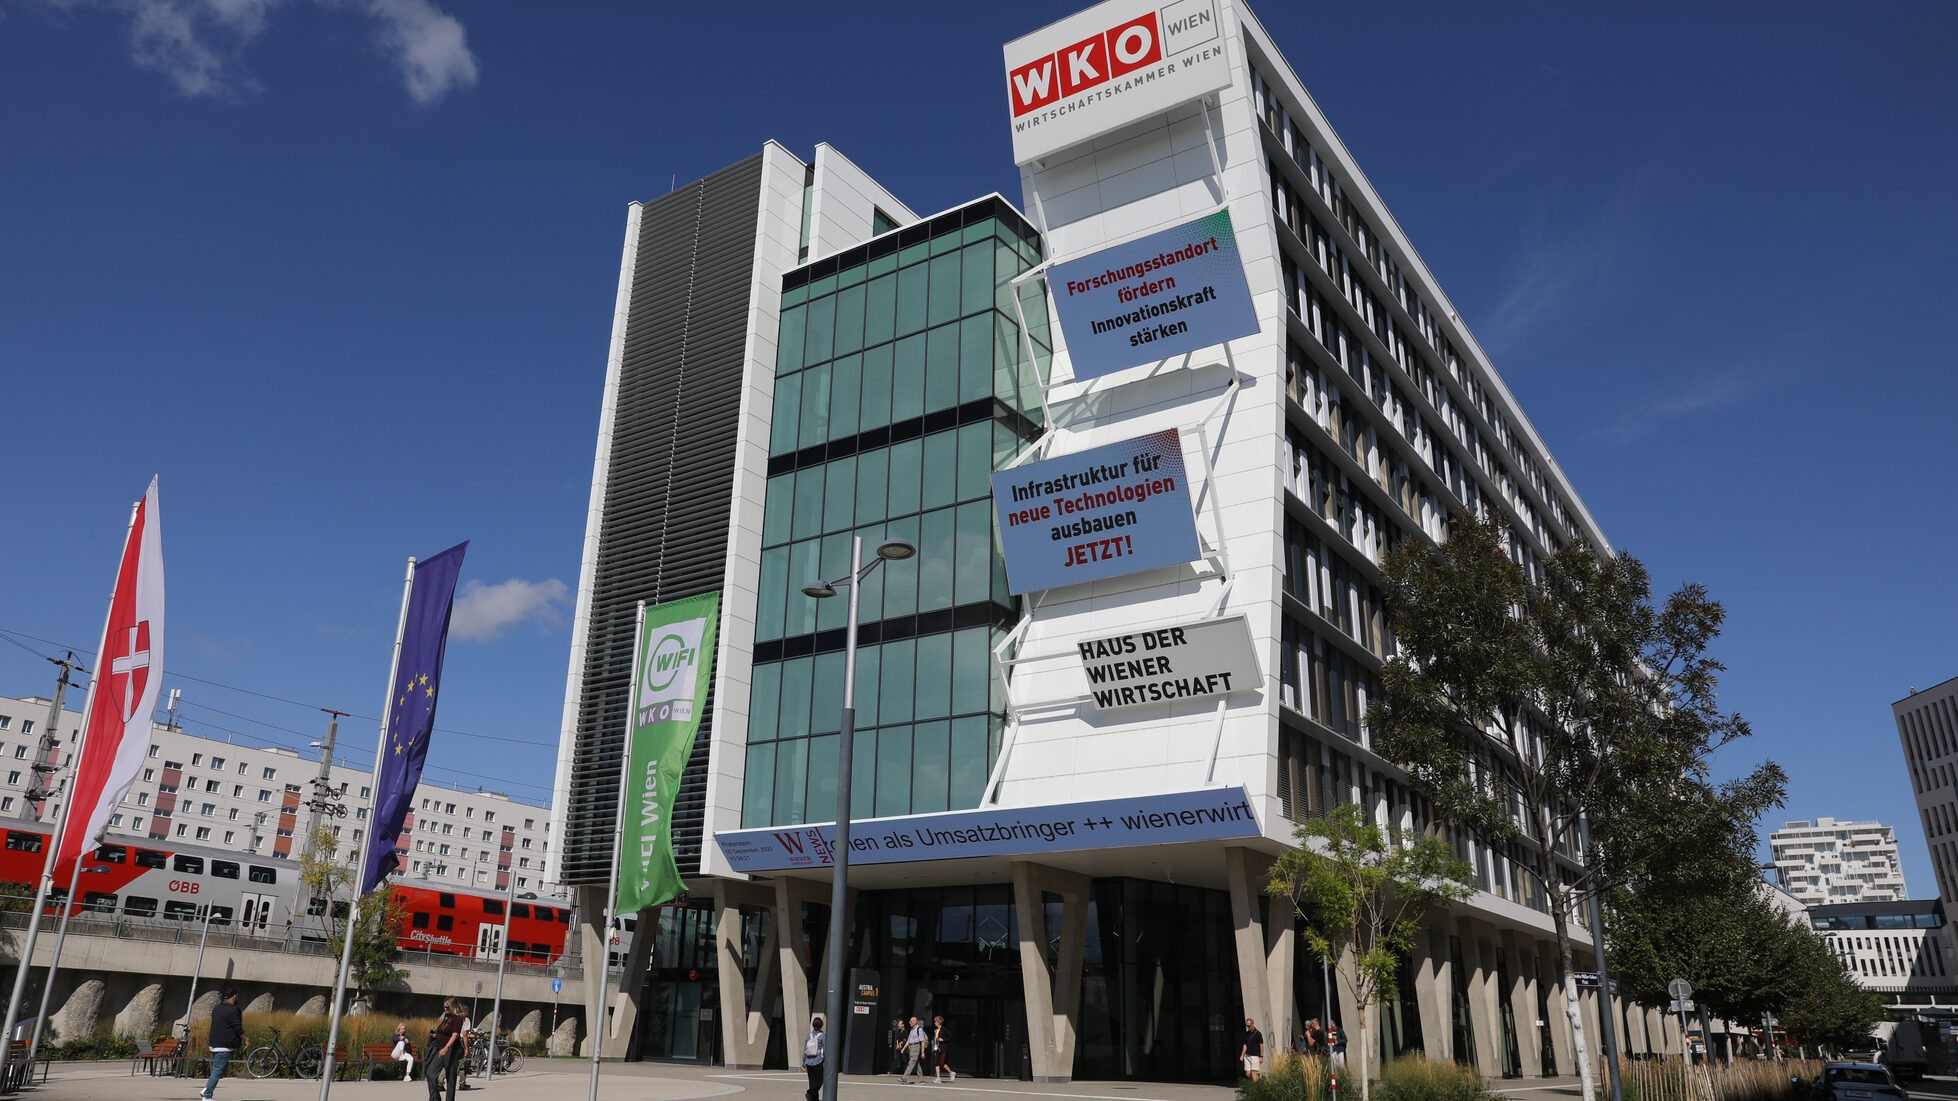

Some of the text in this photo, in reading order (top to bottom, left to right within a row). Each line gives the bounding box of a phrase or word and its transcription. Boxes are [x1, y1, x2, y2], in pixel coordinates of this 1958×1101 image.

[1013, 9, 1211, 106] WKO WIEN
[1015, 45, 1222, 133] WIRTSCHAFTSKAMMER WIEN
[1066, 236, 1219, 297] Forschungsstandort
[1117, 276, 1177, 304] fördern
[1091, 286, 1217, 335] Innovationskraft
[1129, 320, 1188, 347] stärken
[1011, 453, 1161, 502] Infrastruktur für
[1008, 476, 1176, 527] neue Technologien
[1051, 510, 1137, 541] ausbauen
[1064, 535, 1133, 568] JETZT!
[656, 648, 696, 672] WIFI
[1079, 627, 1187, 661] HAUS DER
[1086, 656, 1173, 684] WIENER
[1093, 672, 1232, 708] WIRTSCHAFT
[639, 704, 670, 727] WKO
[641, 760, 660, 827] Wien
[882, 831, 914, 849] als
[915, 820, 1076, 847] Umsatzbringer
[1120, 801, 1255, 831] wienerwirt
[772, 831, 804, 855] W
[806, 830, 832, 864] NEWS
[168, 880, 200, 894] ÖBB
[410, 930, 452, 945] CityShuttle
